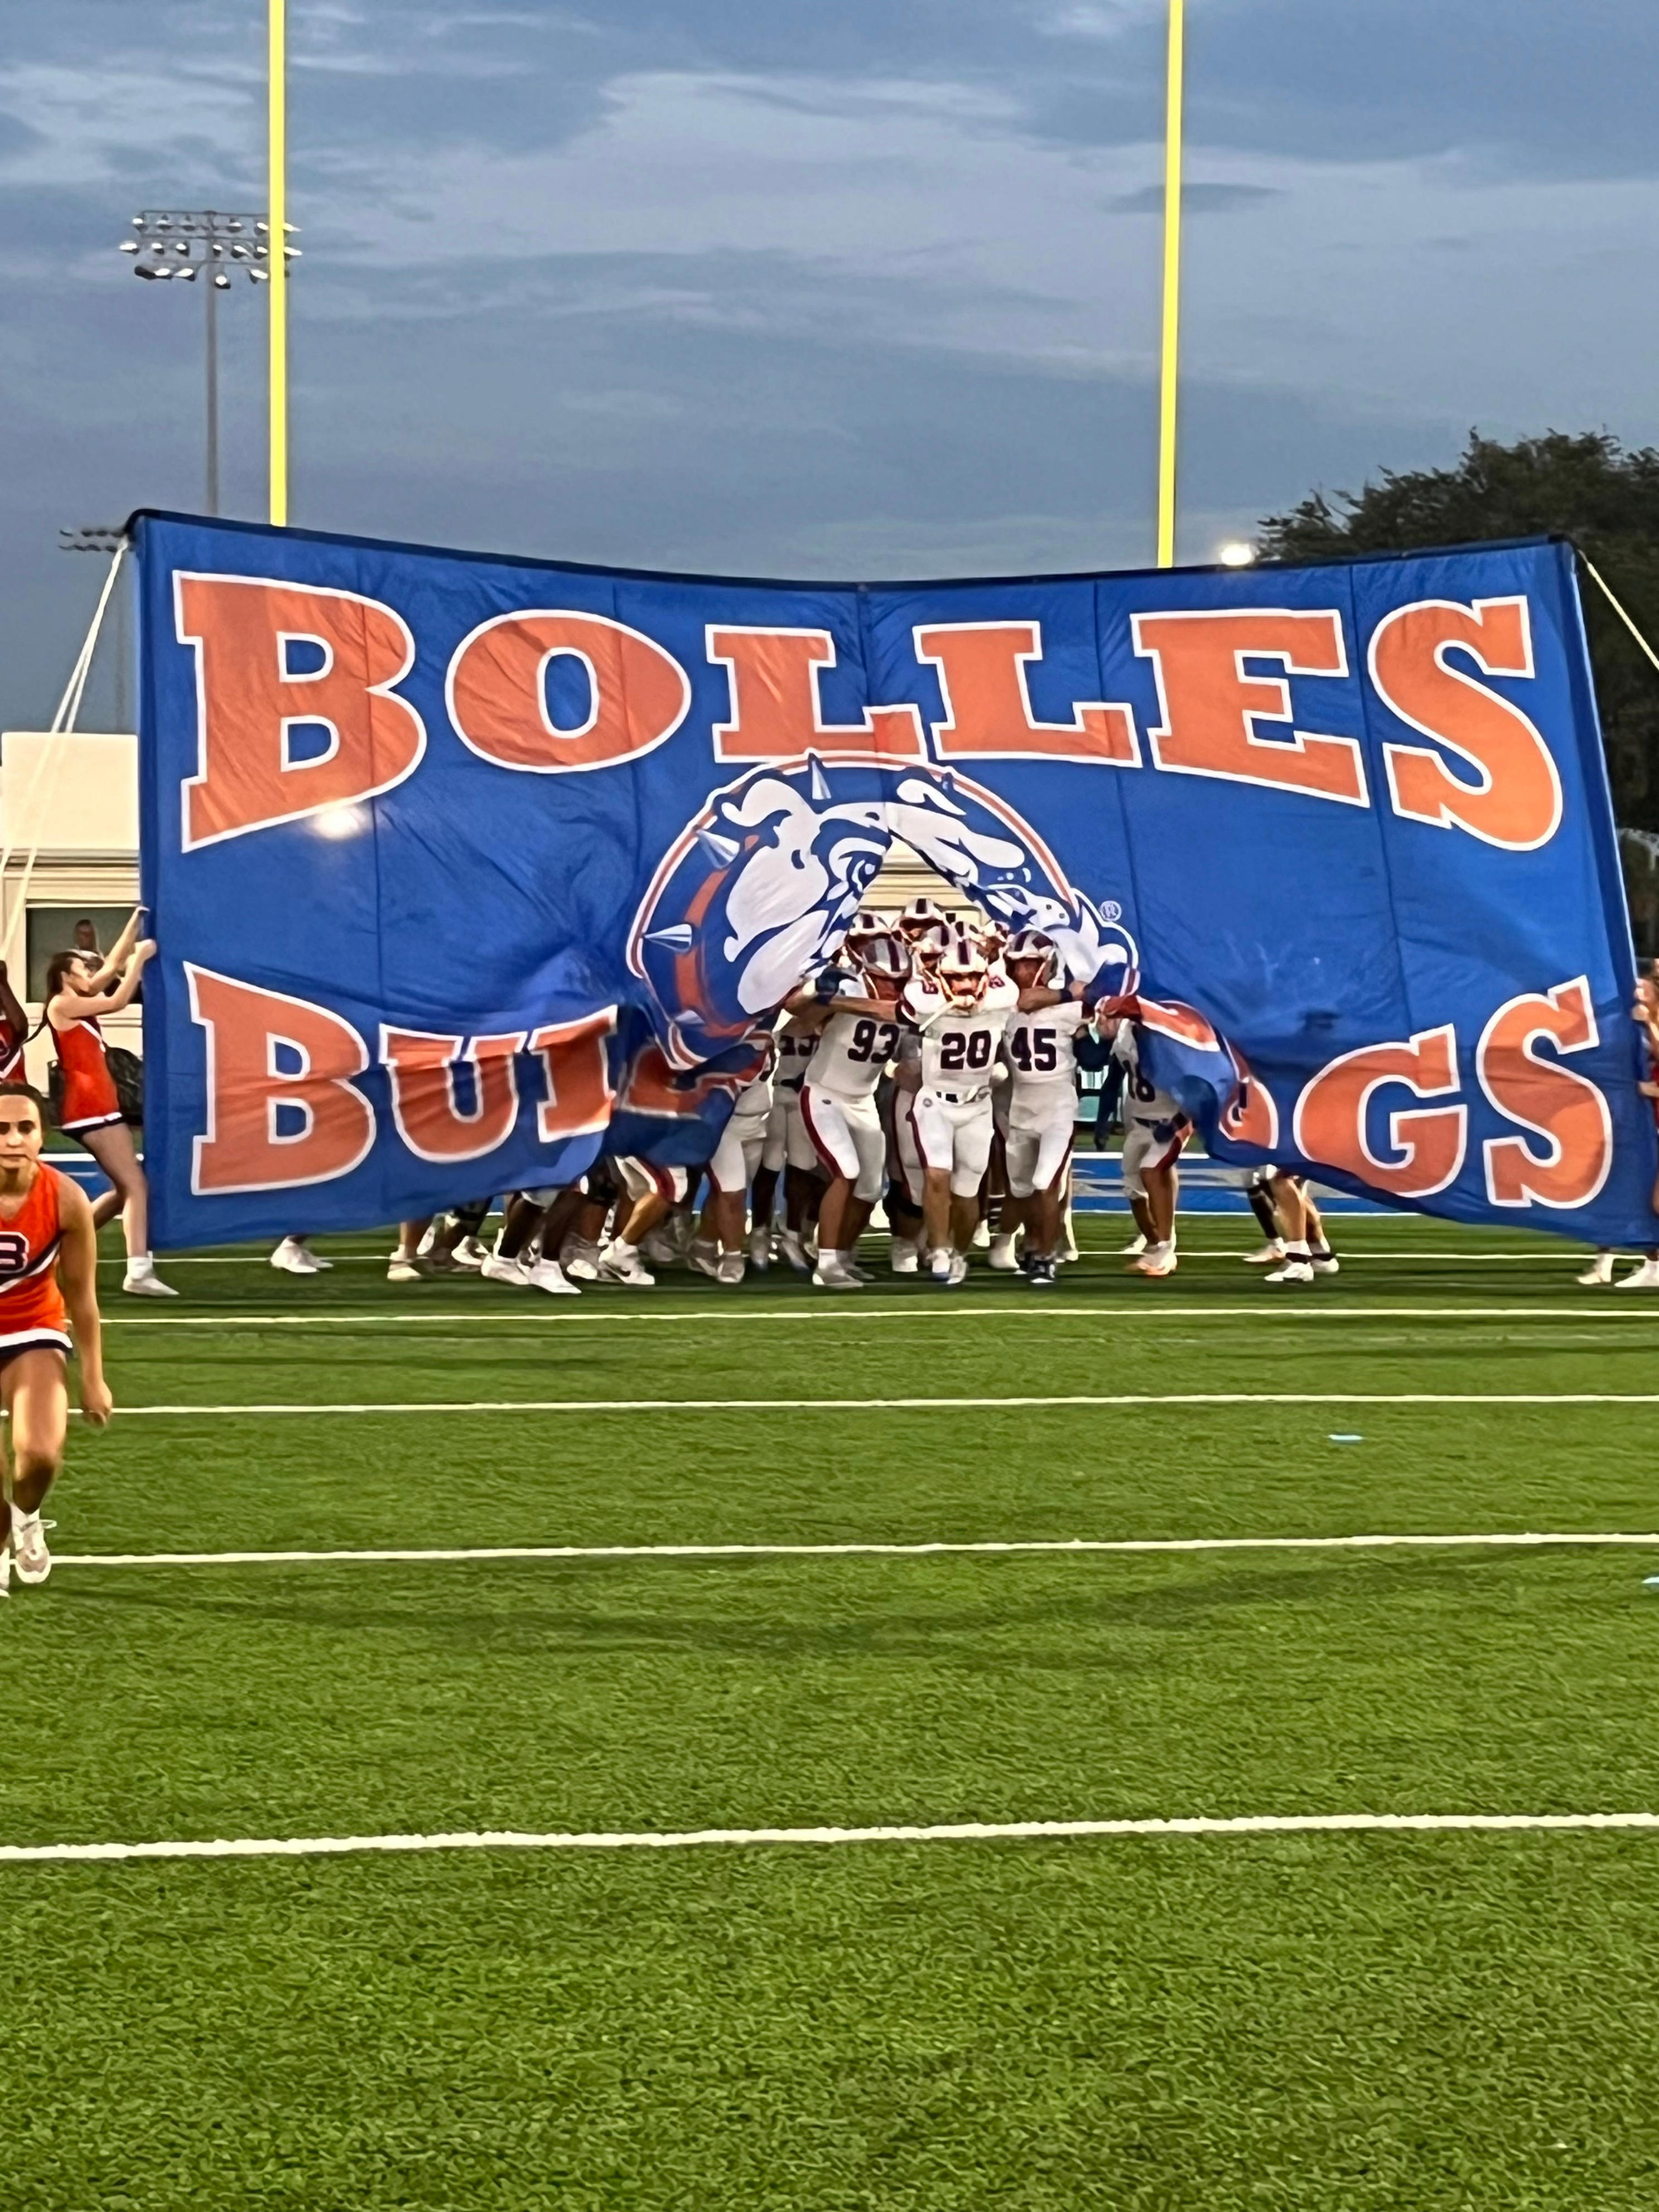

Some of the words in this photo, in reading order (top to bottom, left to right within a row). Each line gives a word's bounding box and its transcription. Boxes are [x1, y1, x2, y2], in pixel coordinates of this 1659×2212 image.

[172, 569, 1563, 854] BOLLES
[847, 1020, 900, 1064] 93
[941, 1030, 991, 1070] 20
[1011, 1027, 1057, 1071] 45
